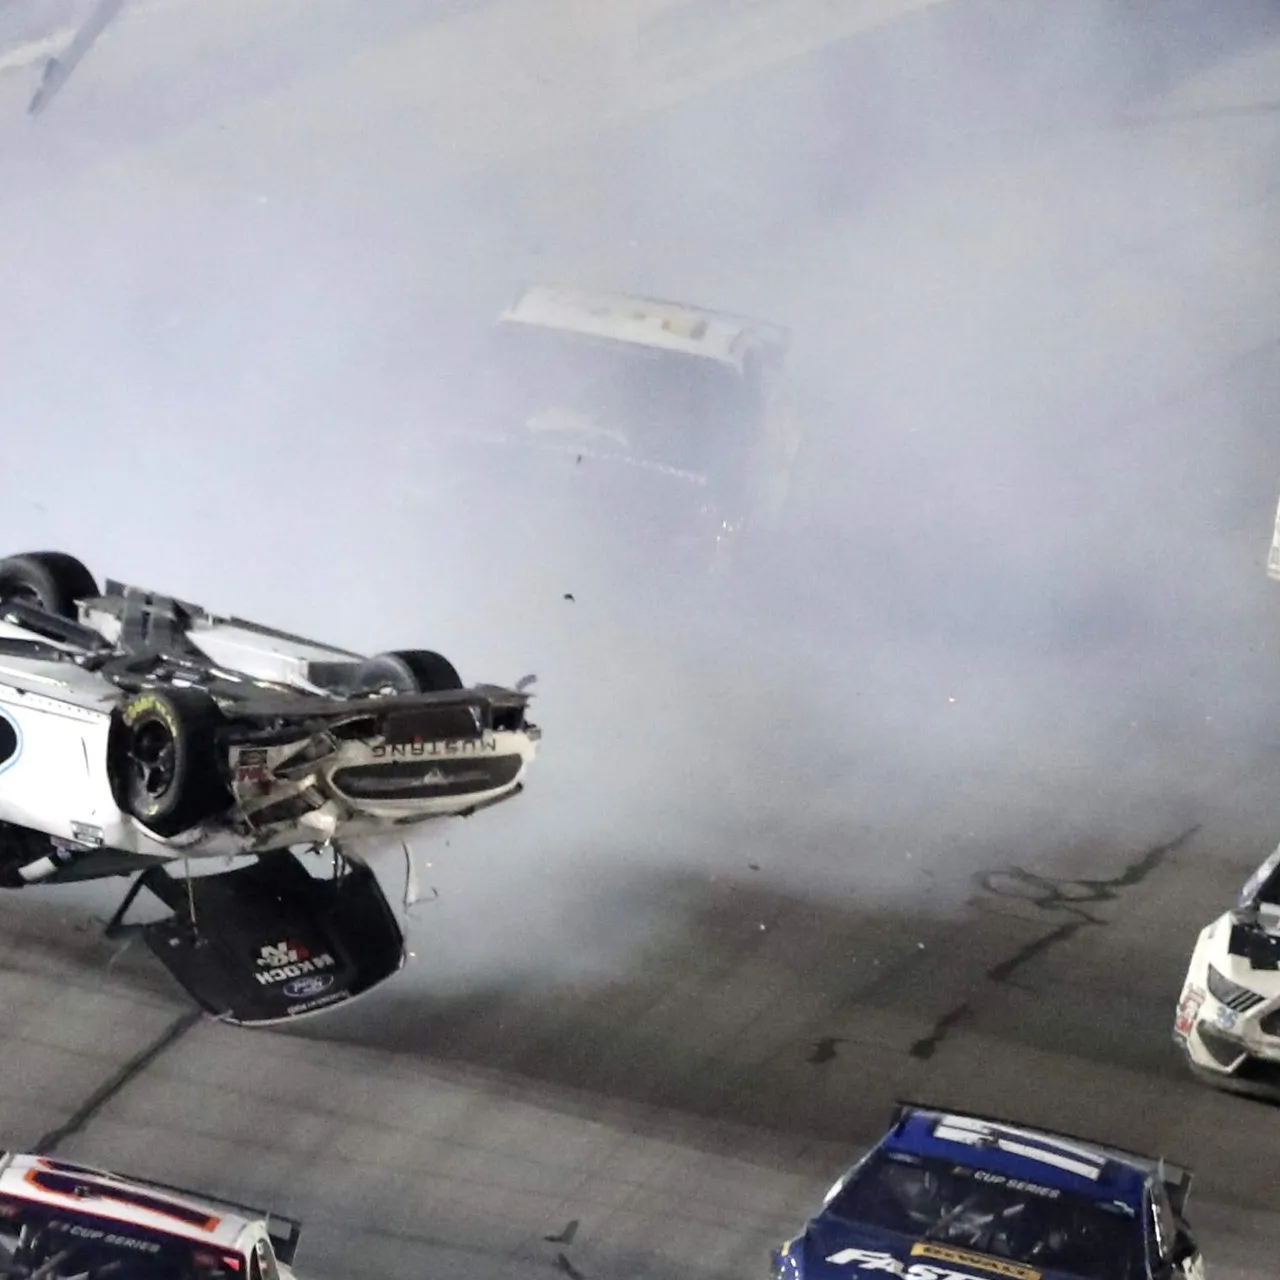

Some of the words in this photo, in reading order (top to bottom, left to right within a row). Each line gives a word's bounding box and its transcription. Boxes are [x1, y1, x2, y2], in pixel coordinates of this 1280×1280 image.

[974, 1170, 1006, 1184] CUP
[1006, 1178, 1061, 1199] SERIES
[69, 1224, 105, 1241] CUP
[104, 1233, 161, 1253] SERIES
